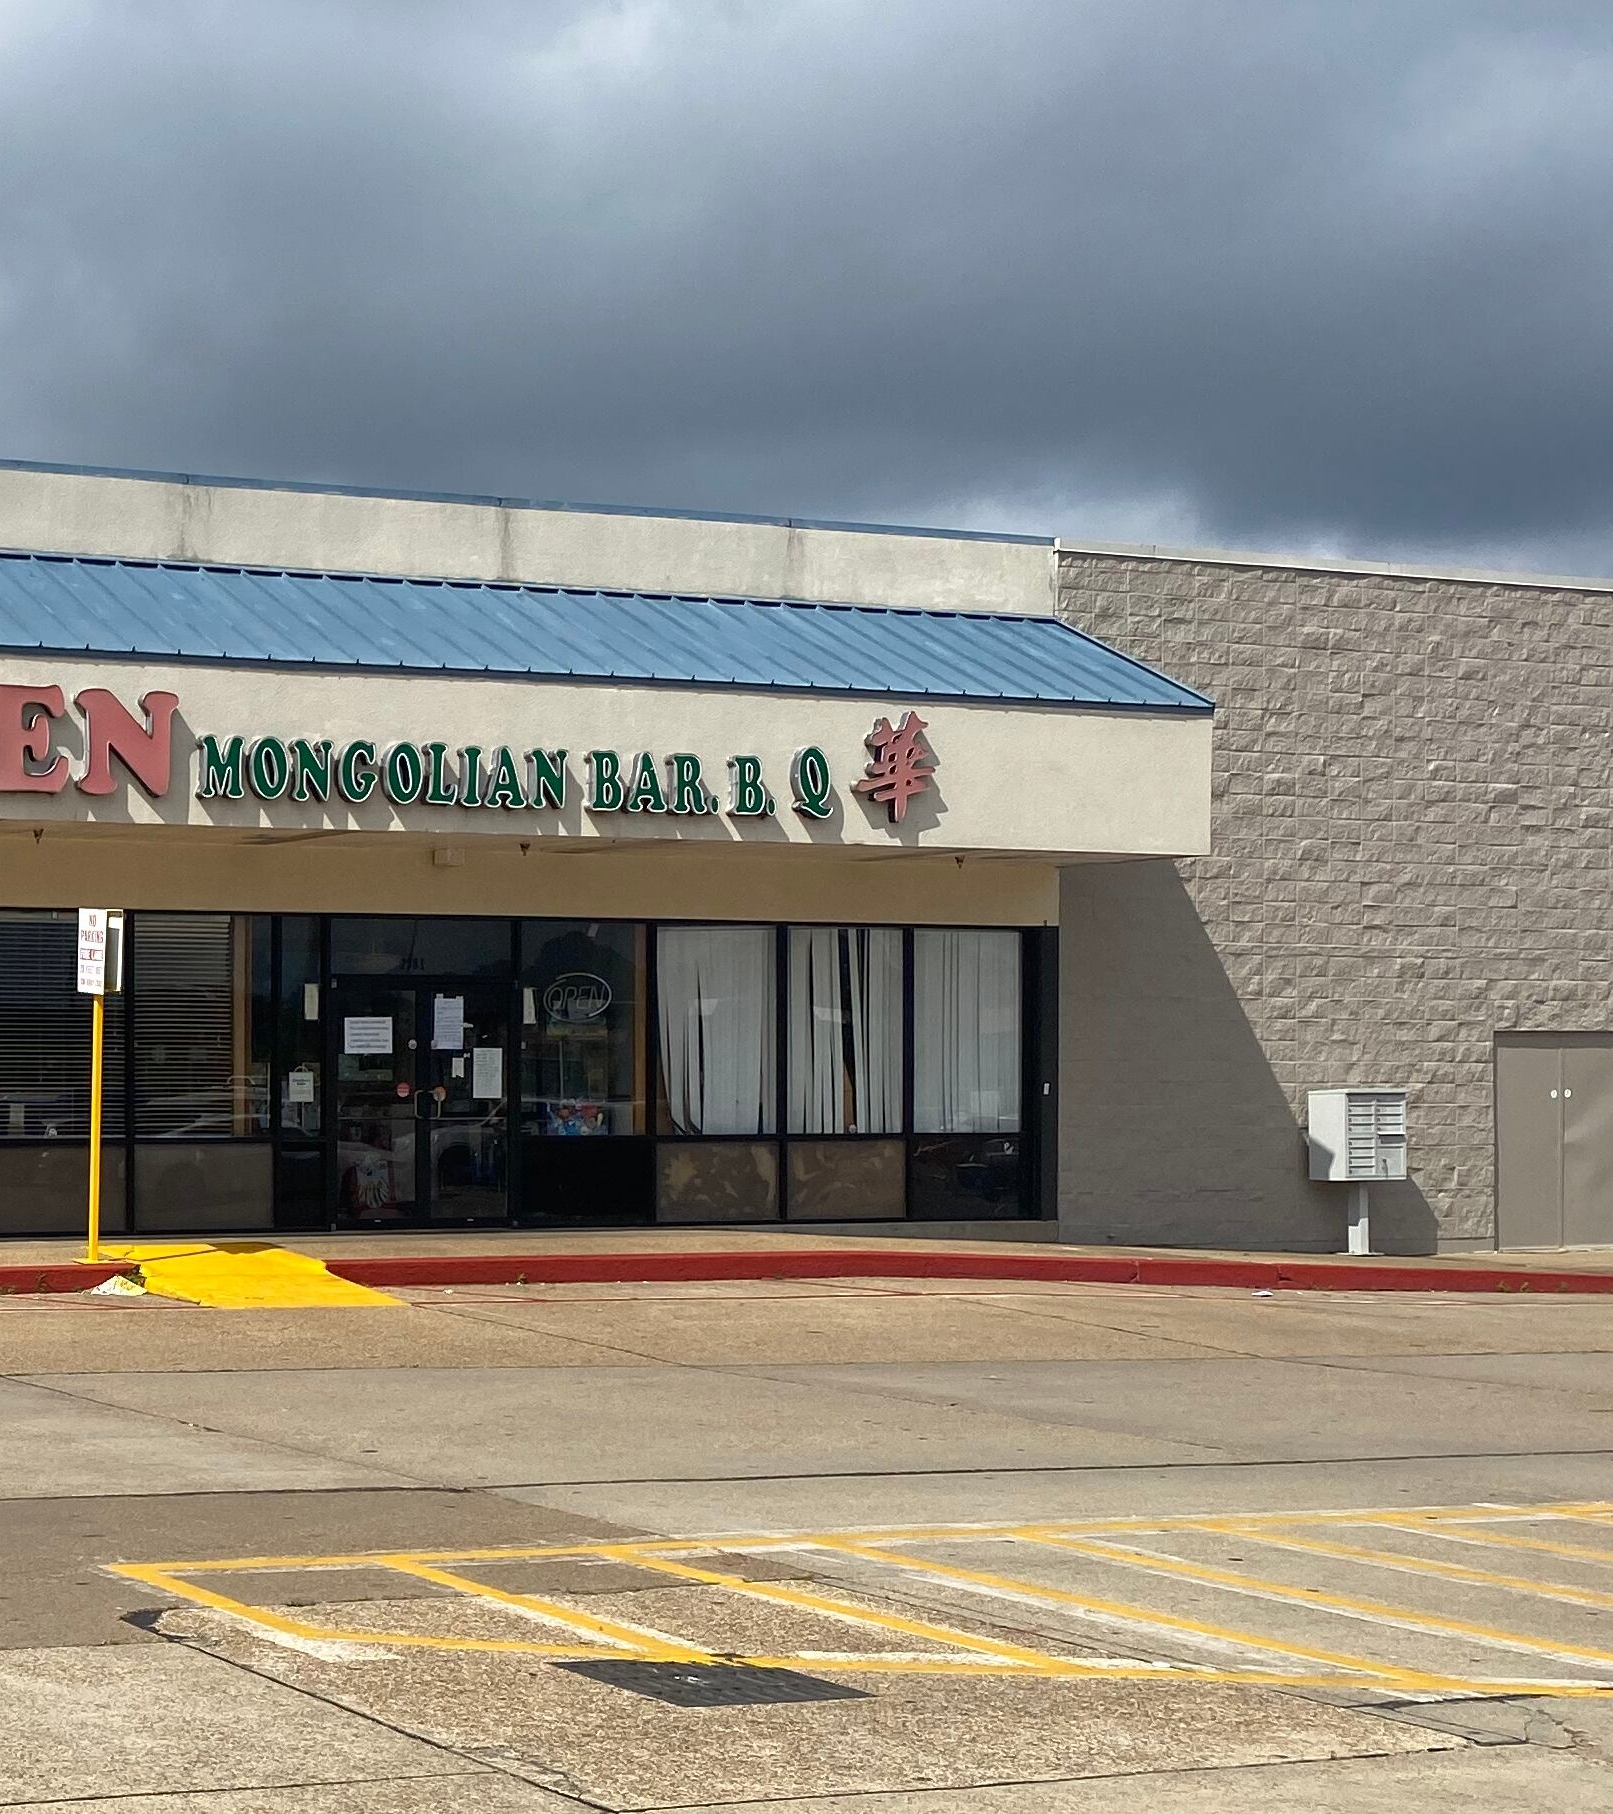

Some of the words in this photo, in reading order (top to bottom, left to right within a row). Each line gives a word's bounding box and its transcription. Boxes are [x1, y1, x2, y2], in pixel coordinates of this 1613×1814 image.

[196, 733, 568, 809] MONGOLIAN
[791, 744, 834, 820] Q
[851, 710, 936, 824] 華
[89, 914, 96, 927] NO
[80, 930, 104, 943] PARKING
[547, 985, 606, 1011] OPEN
